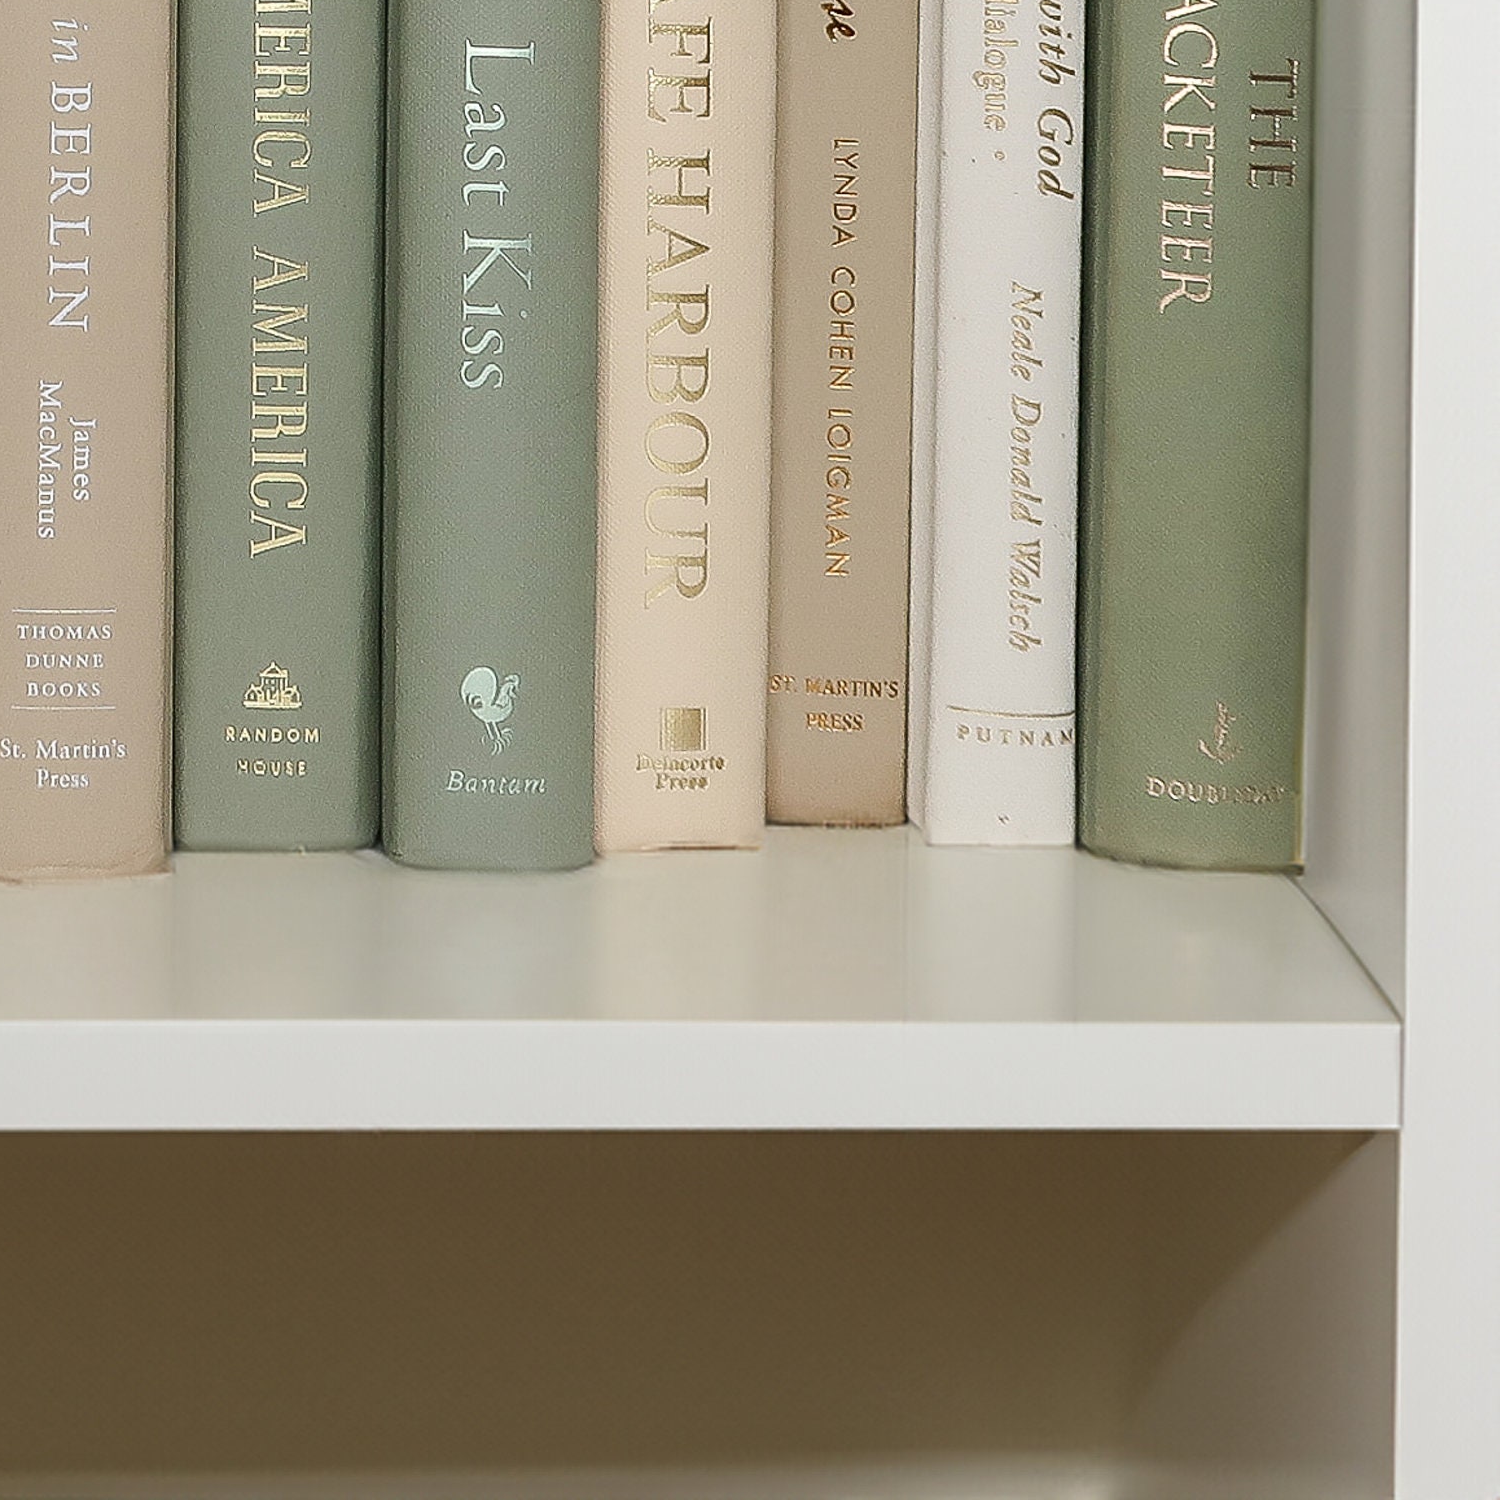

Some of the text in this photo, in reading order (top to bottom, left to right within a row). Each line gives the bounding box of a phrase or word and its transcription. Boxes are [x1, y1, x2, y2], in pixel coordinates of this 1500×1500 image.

[50, 17, 89, 63] in
[1247, 56, 1301, 190] THE
[1036, 107, 1075, 201] God
[48, 80, 94, 333] BERLIN
[460, 38, 536, 392] Last Kiss
[824, 136, 859, 578] LYNDA COHEN LOIGMAN
[643, 147, 712, 610] HARBOUR
[249, 246, 309, 559] AMERICA
[36, 379, 63, 540] MacManus
[69, 416, 98, 502] James
[1008, 279, 1045, 654] Neale Donald Walsch
[16, 624, 113, 641] THOMAS
[24, 653, 105, 669] DUNNE
[26, 682, 102, 698] BOOKS
[769, 673, 900, 699] ST. MARTIN'S
[805, 710, 866, 732] PRESS
[224, 726, 321, 744] RANDOM
[0, 737, 128, 760] St. Martin's
[236, 759, 308, 778] HOUSE
[635, 754, 726, 772] Delacorte
[34, 768, 90, 789] Press
[445, 769, 547, 795] Bantam
[654, 773, 709, 791] Press
